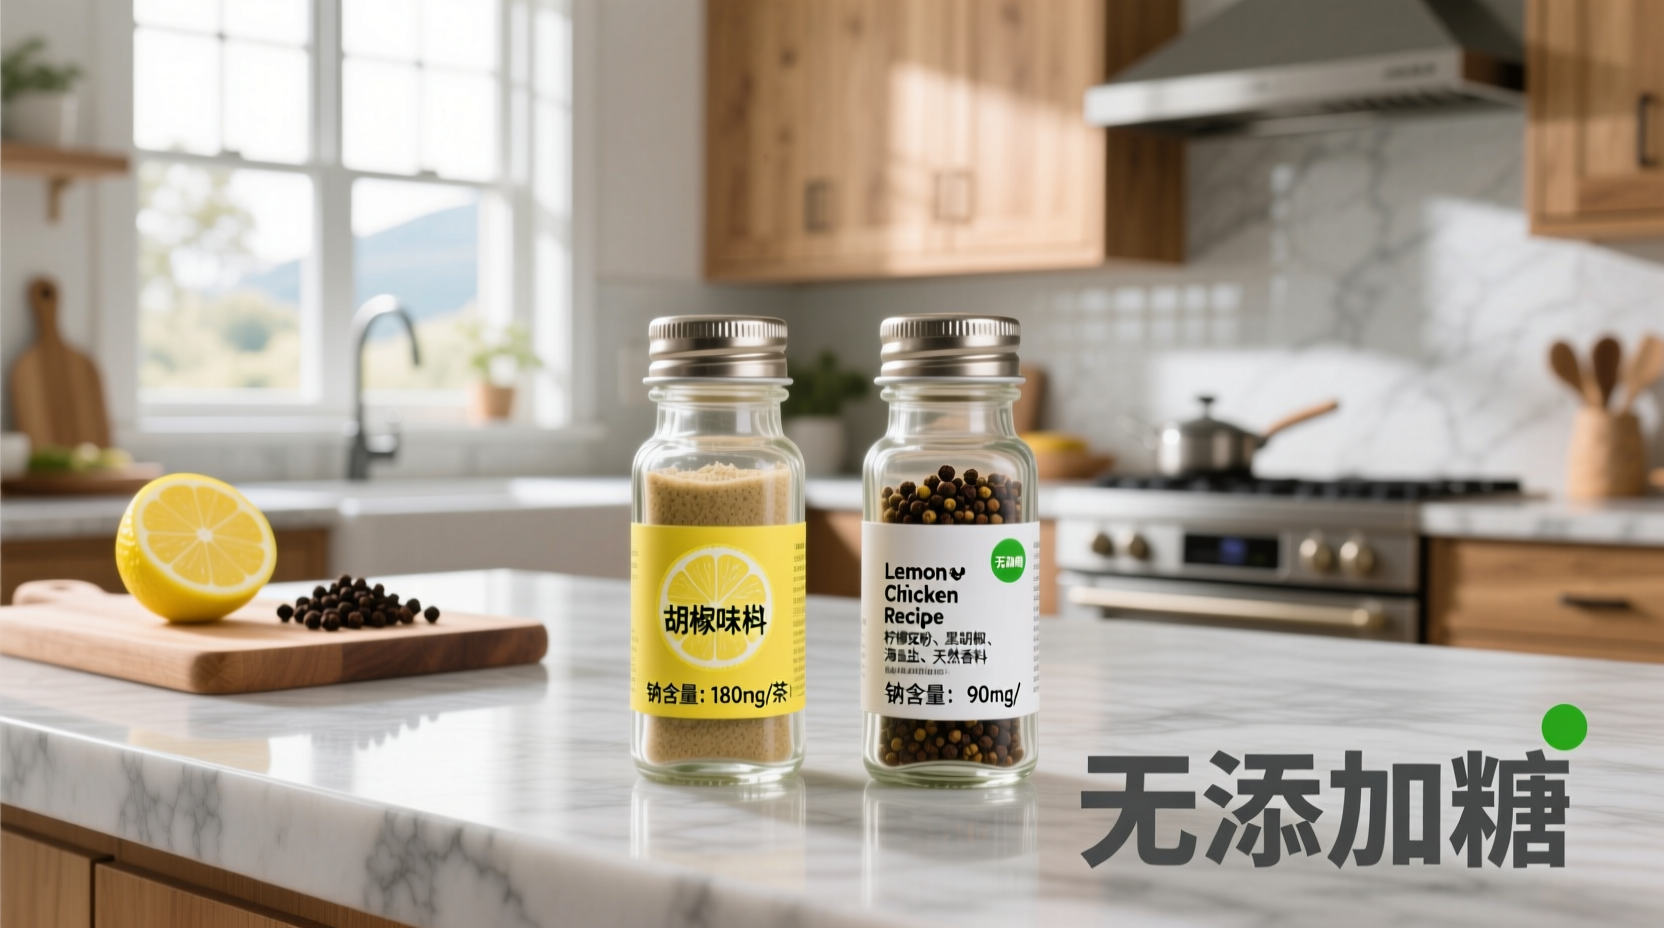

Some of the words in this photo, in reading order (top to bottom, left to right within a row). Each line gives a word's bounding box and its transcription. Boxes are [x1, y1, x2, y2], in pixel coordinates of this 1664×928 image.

[885, 563, 947, 581] Lemon
[885, 585, 958, 603] Chicken
[885, 607, 944, 629] Recipe
[967, 682, 1021, 707] 90mg/
